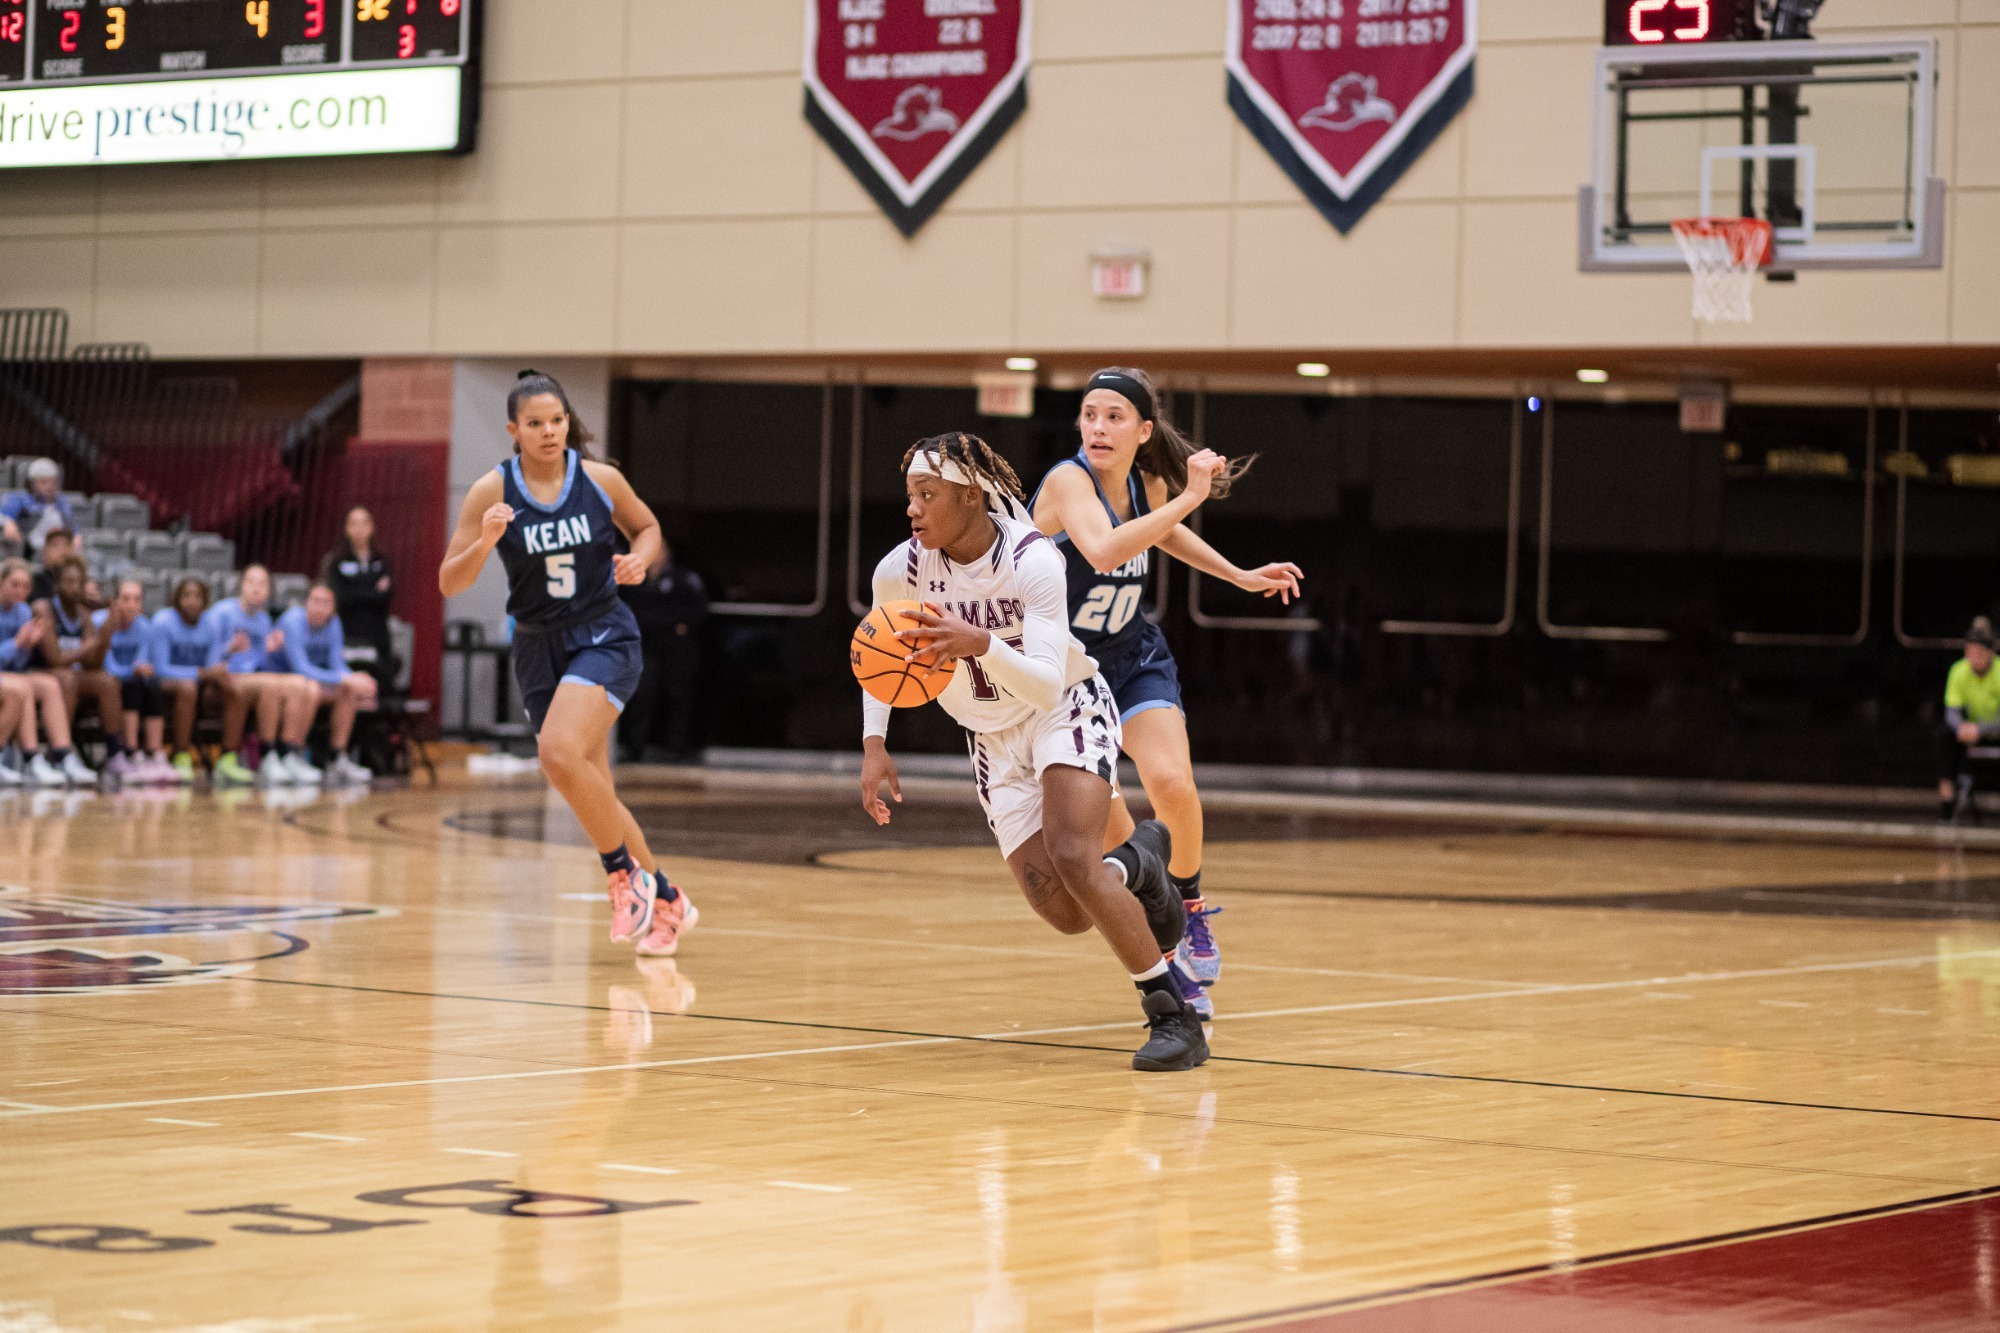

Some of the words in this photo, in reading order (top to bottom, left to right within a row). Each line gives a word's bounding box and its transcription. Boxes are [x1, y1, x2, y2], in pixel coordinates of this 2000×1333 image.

[60, 10, 81, 52] 2
[105, 6, 126, 50] 3
[246, 0, 269, 38] 4
[304, 0, 325, 39] 3
[398, 24, 417, 59] 3
[523, 513, 592, 555] KEAN
[545, 552, 577, 599] 5
[1094, 549, 1149, 578] AN
[945, 598, 1025, 630] MAPO
[1071, 584, 1143, 635] 20
